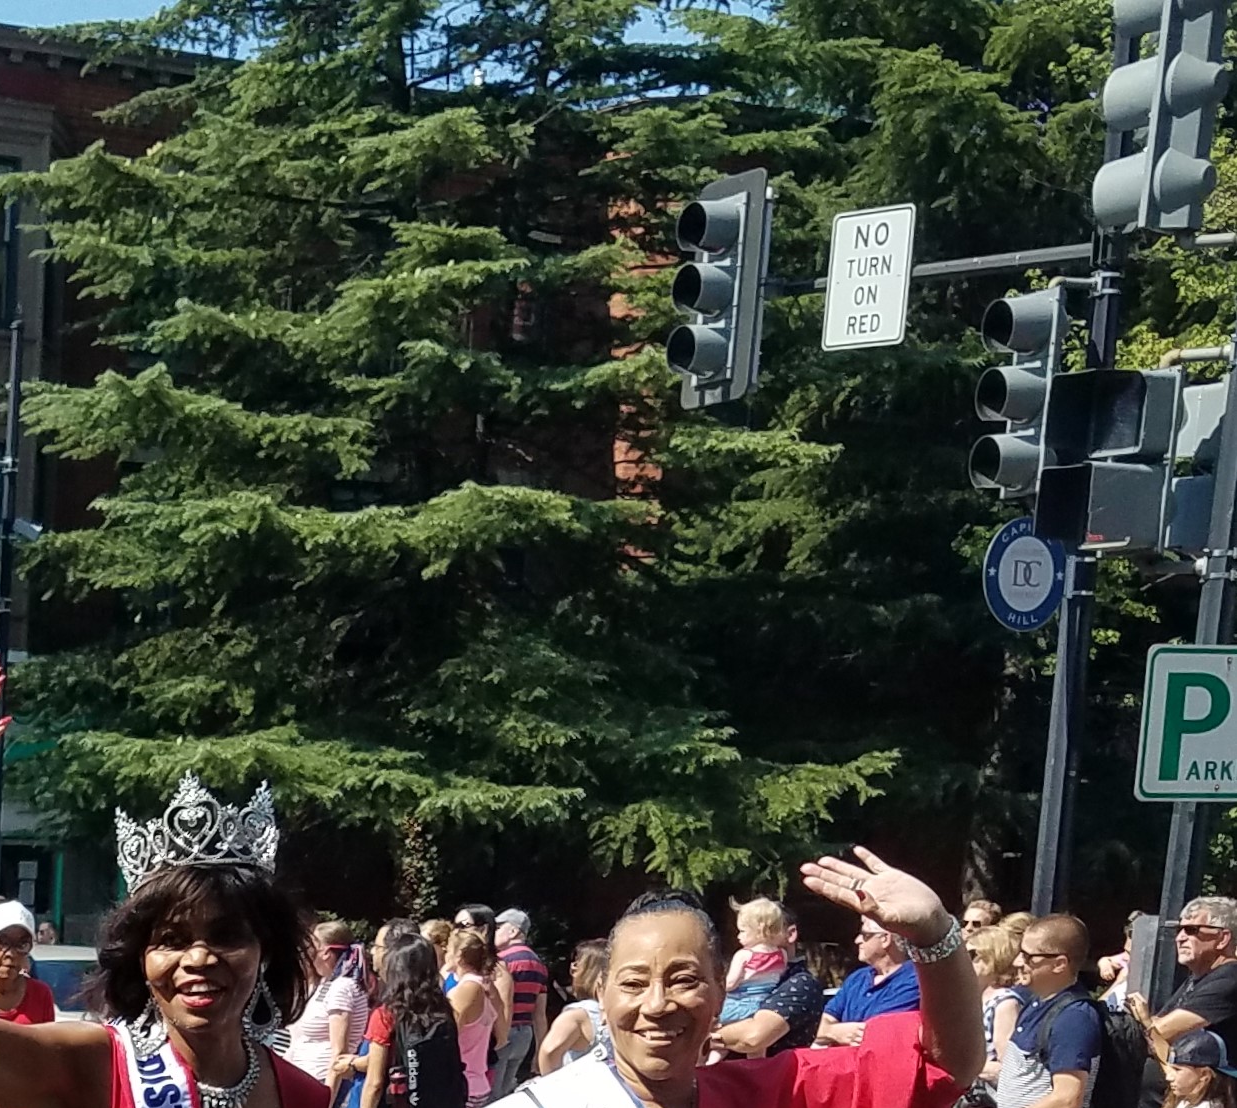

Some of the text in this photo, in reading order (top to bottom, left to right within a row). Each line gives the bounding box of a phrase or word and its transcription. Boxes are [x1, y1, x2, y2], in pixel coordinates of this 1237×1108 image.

[855, 222, 889, 249] NO
[847, 254, 892, 278] TURN
[854, 285, 878, 306] ON
[846, 314, 881, 335] RED
[1011, 559, 1043, 588] DC
[1007, 612, 1039, 625] HILL
[407, 1048, 420, 1090] adidas
